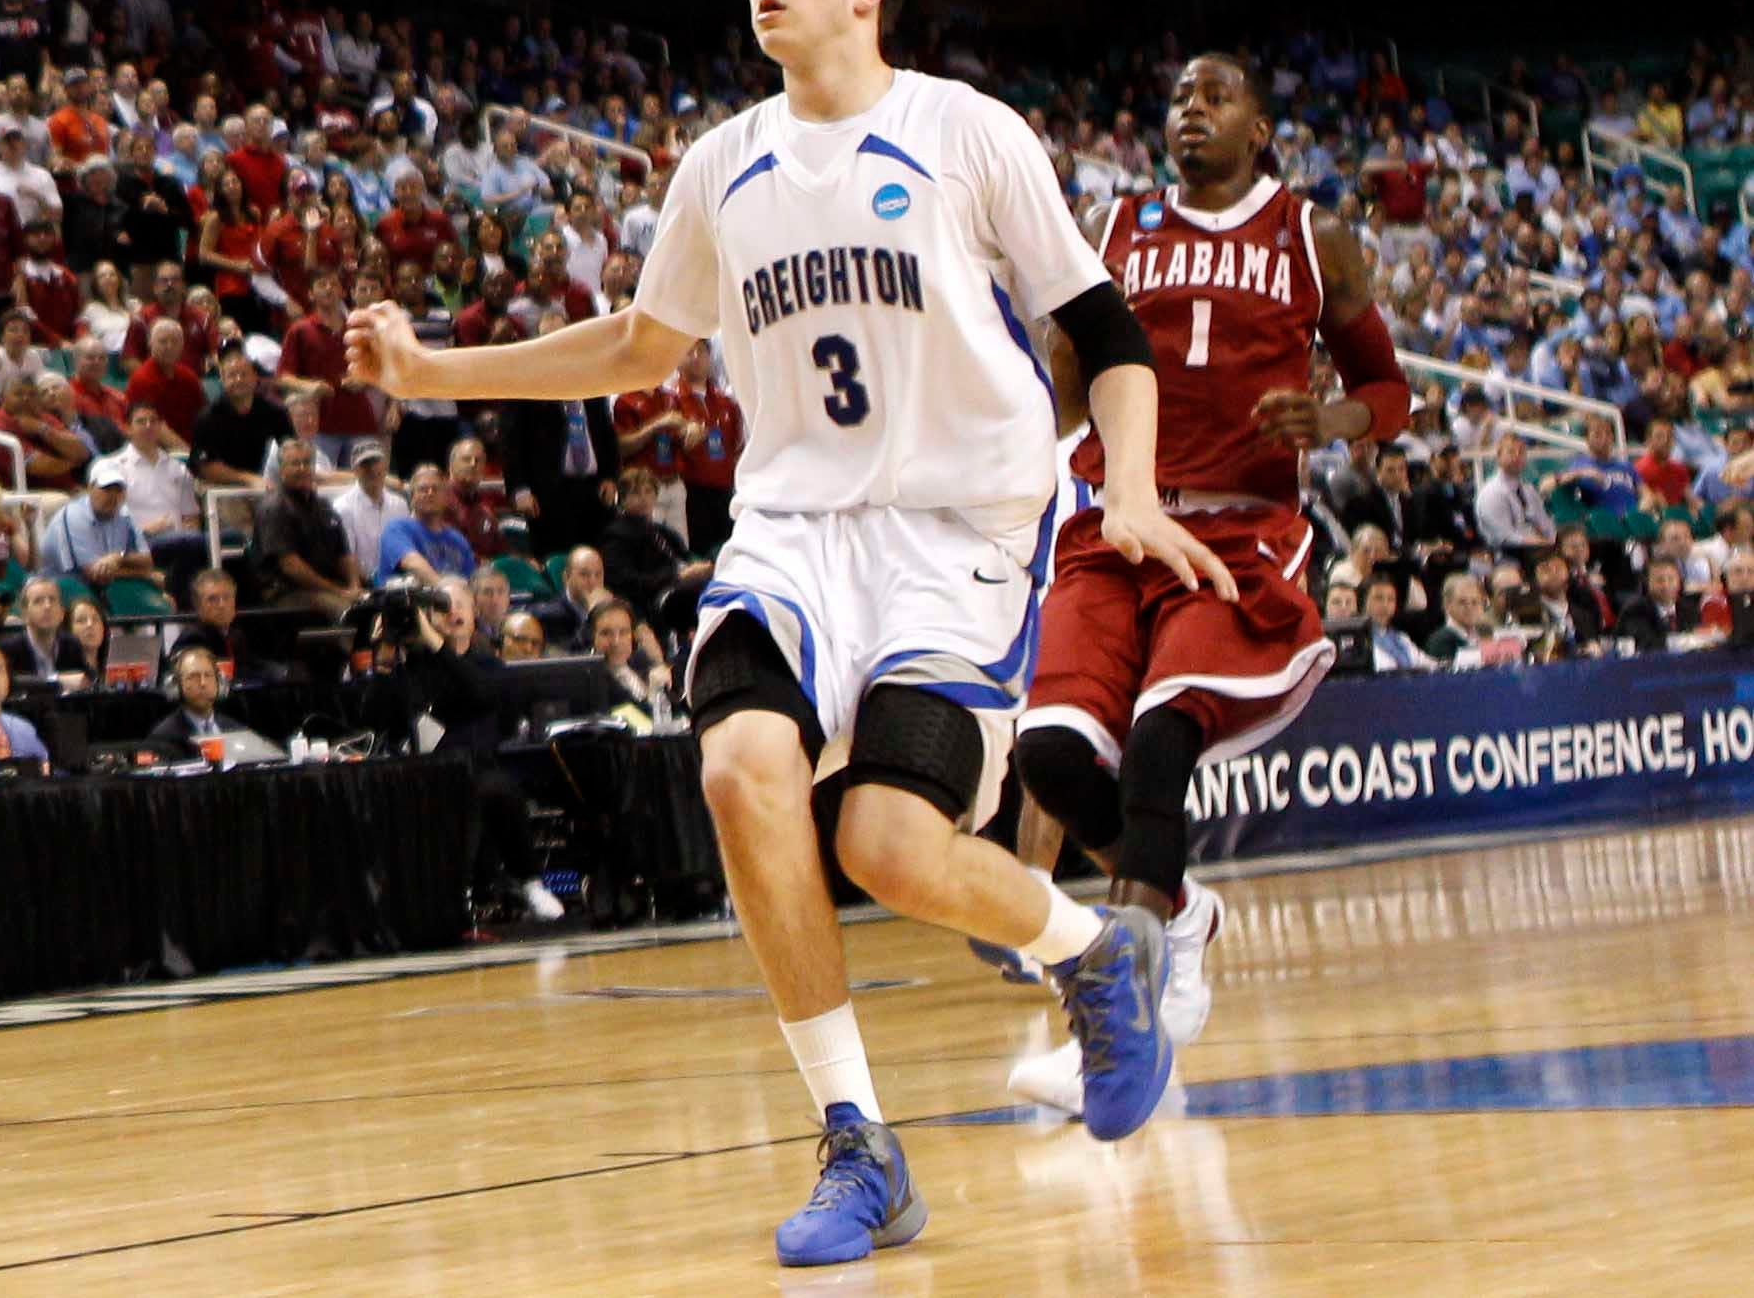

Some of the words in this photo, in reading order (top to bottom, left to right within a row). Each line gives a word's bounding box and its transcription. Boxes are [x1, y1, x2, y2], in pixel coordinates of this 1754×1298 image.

[742, 246, 925, 337] CREIGHTON
[1124, 241, 1292, 305] ALABAMA
[1186, 299, 1212, 367] 1
[812, 334, 871, 428] 3
[1297, 737, 1438, 809] COAST
[1446, 712, 1697, 795] CONFERENCE,
